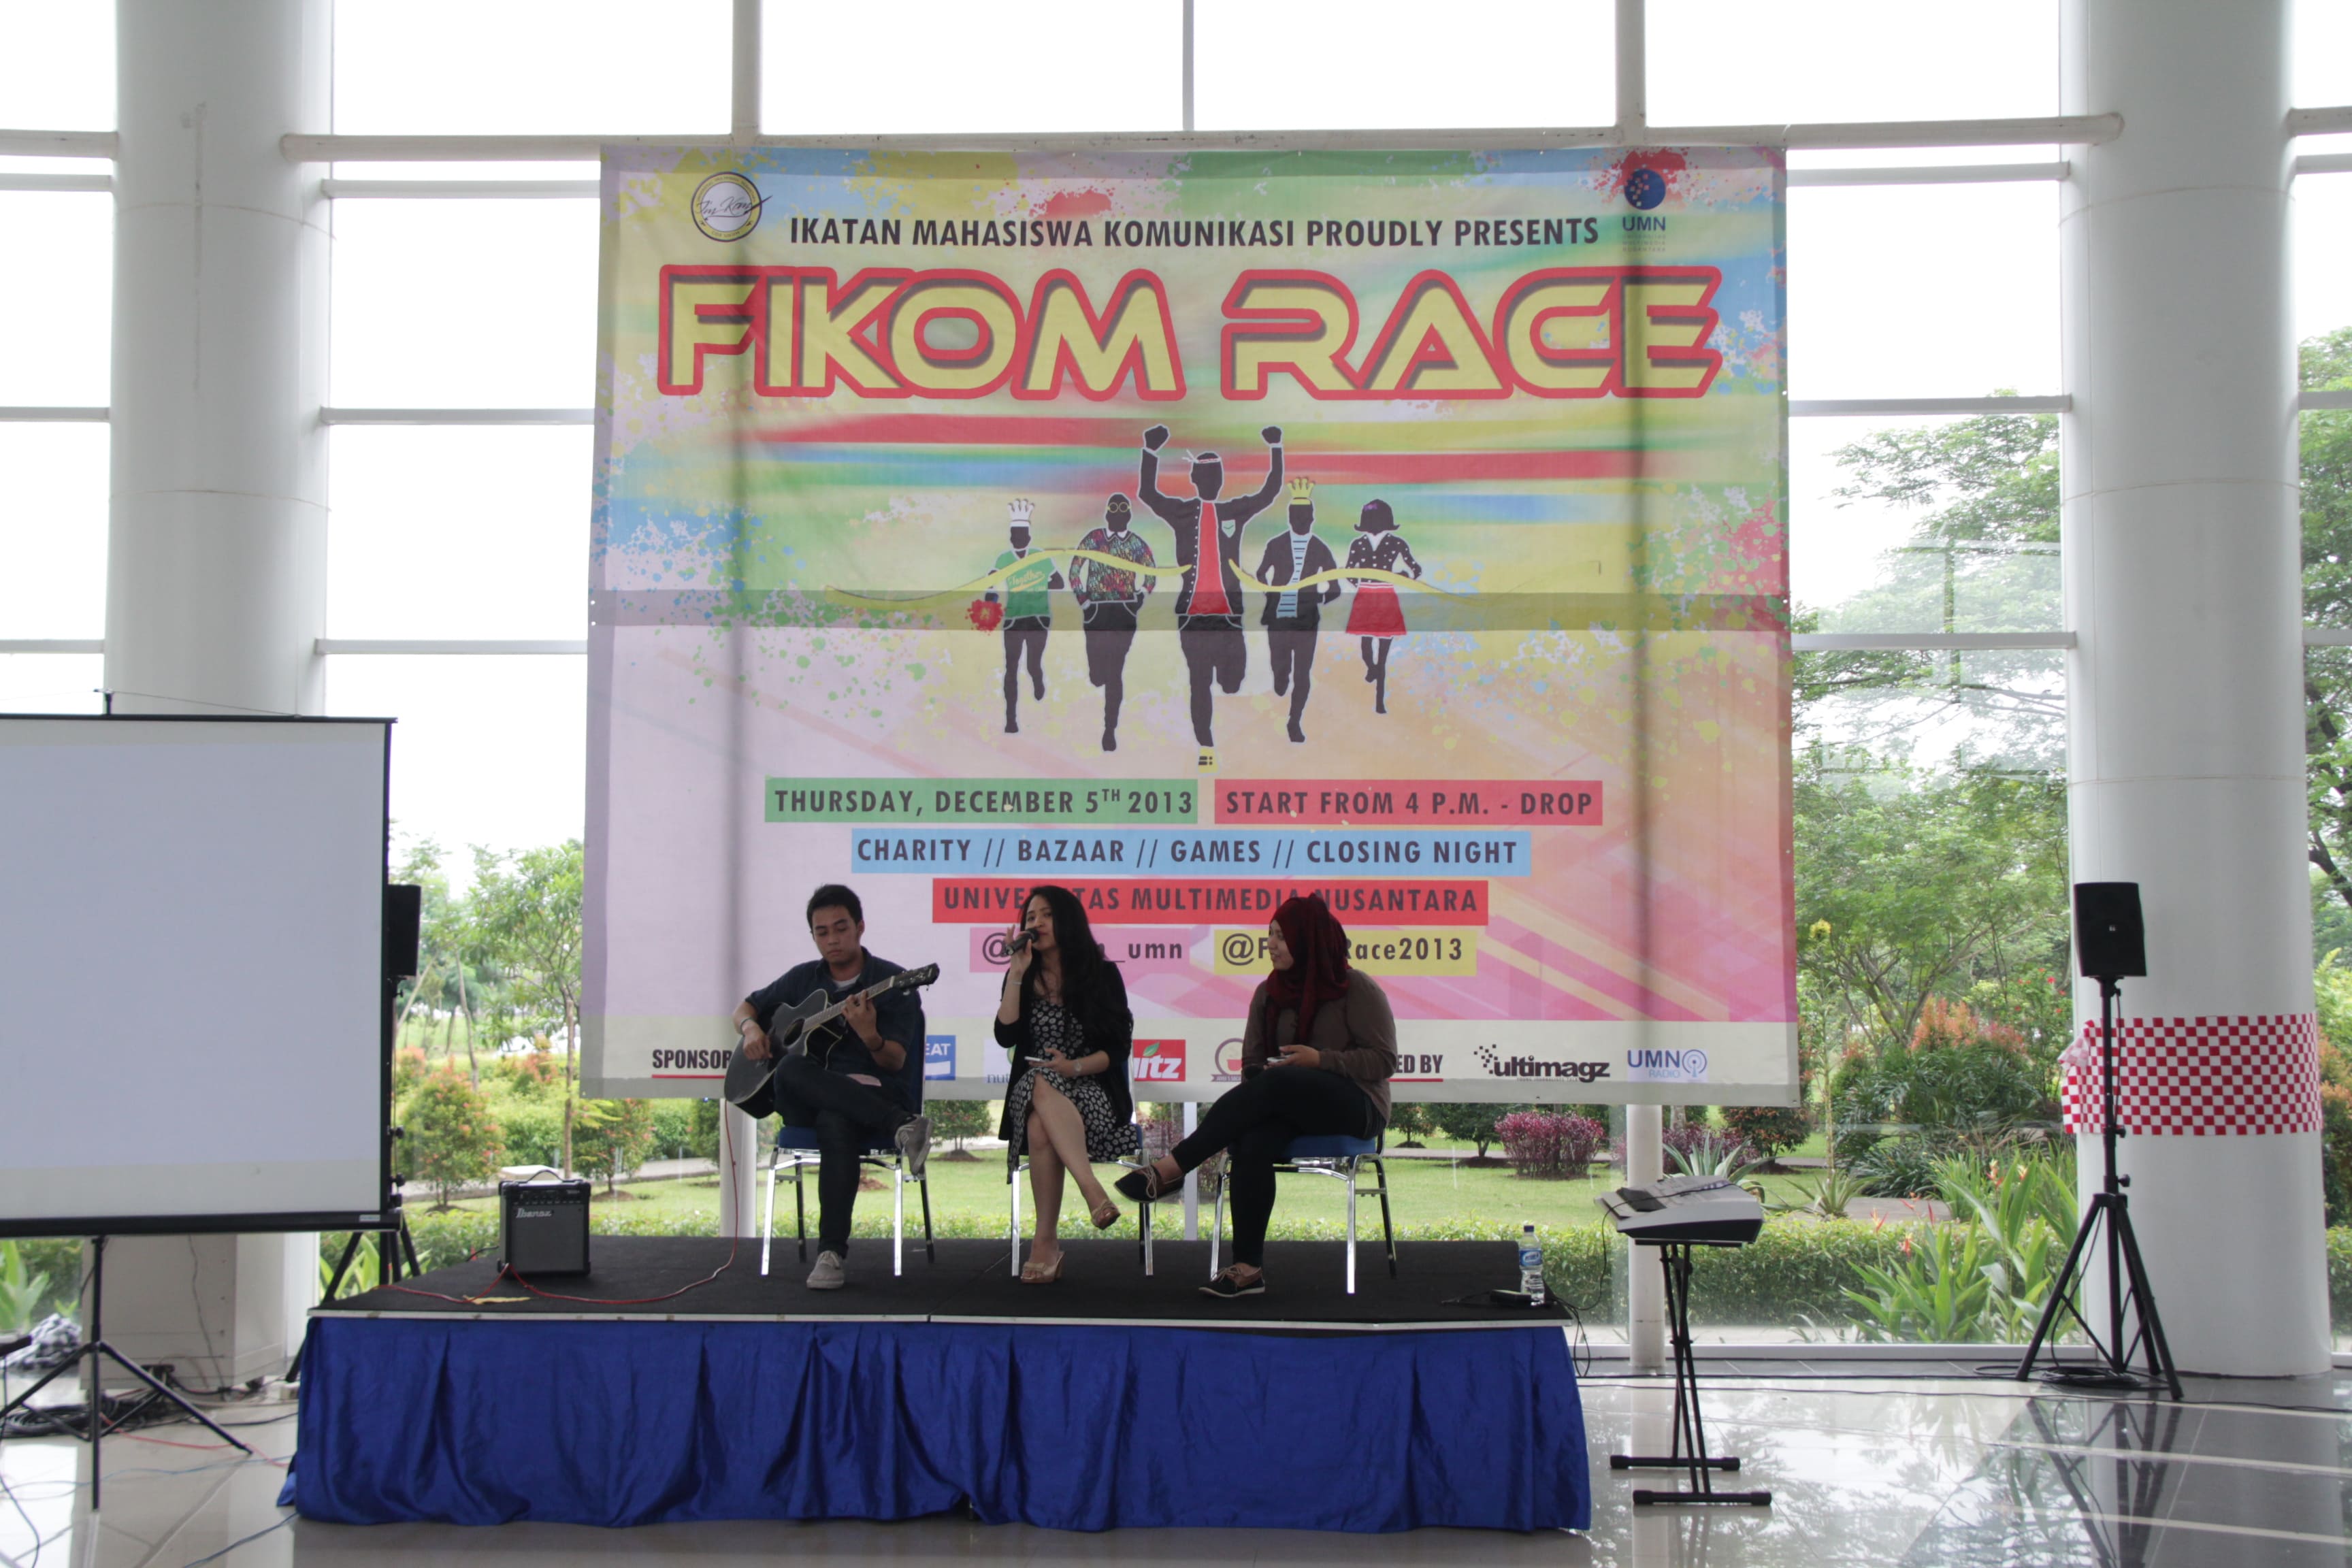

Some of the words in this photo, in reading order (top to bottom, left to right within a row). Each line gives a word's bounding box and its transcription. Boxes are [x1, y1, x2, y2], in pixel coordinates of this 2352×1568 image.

[791, 217, 901, 245] IKATAN
[912, 220, 1093, 247] MAHASISWA
[1105, 220, 1294, 247] KOMUNIKASI
[1307, 220, 1443, 247] PROUDLY
[1455, 217, 1599, 246] PRESENTS
[1622, 216, 1666, 231] UMN
[658, 266, 1187, 401] FIKOM
[1222, 267, 1722, 400] RACE
[774, 790, 922, 817] THURSDAY,
[936, 790, 1073, 813] DECEMBER
[1085, 788, 1120, 813] 5TH
[1128, 791, 1192, 814] 2013
[1226, 791, 1308, 814] START
[1320, 791, 1394, 815] FROM
[1405, 792, 1419, 814] 4
[1432, 792, 1488, 815] P.M.
[1521, 792, 1592, 815] DROP
[858, 838, 971, 861] CHARITY
[1018, 839, 1124, 862] BAZAAR
[1171, 840, 1260, 863] GAMES
[1307, 840, 1420, 864] CLOSING
[1434, 841, 1517, 864] NIGHT
[945, 887, 1120, 910] UNIVETAS
[1316, 889, 1477, 913] NUSANTARA
[1420, 1054, 1443, 1073] BY
[1494, 1055, 1611, 1083] ultimagz
[1627, 1049, 1680, 1068] UMN
[1648, 1069, 1681, 1079] RADIO
